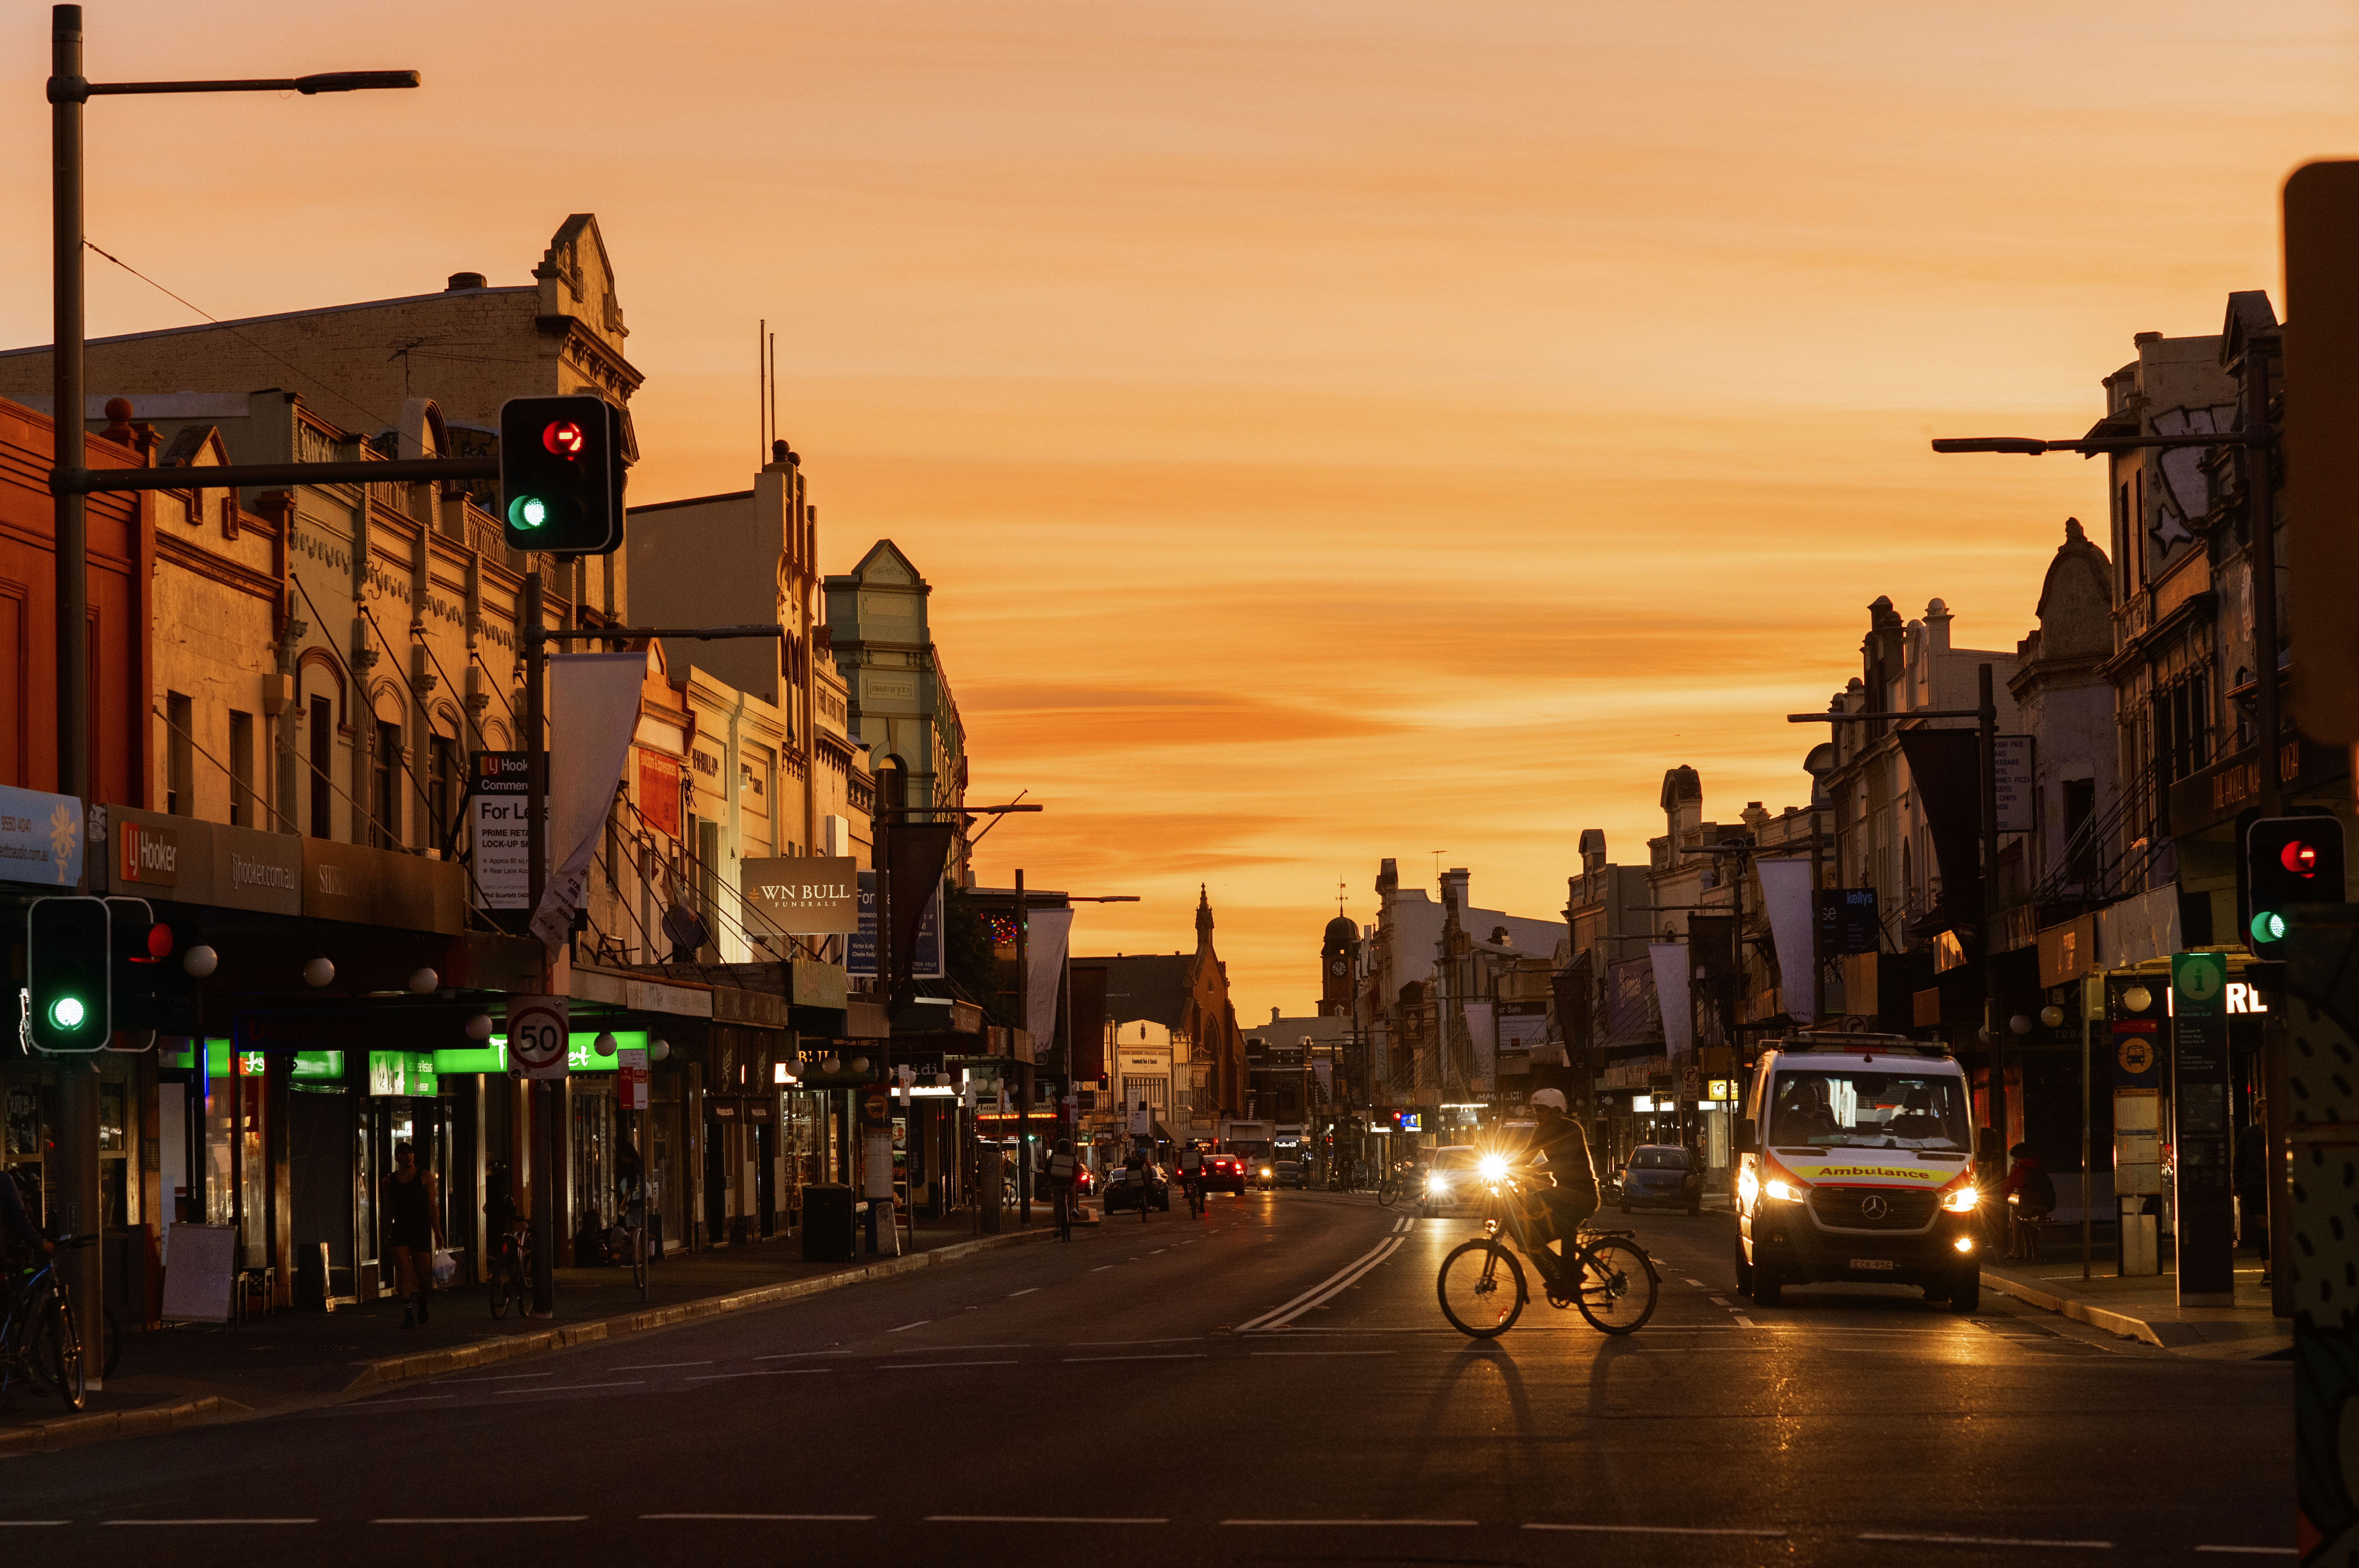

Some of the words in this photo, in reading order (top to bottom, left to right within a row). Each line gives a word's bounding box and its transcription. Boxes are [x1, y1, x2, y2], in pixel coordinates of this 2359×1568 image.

[489, 758, 498, 774] LJ
[501, 758, 528, 771] Hook
[481, 779, 528, 791] Commer
[481, 802, 509, 820] For
[129, 829, 138, 877] LJ
[140, 831, 177, 872] Hooker
[760, 885, 796, 900] WN
[802, 884, 850, 899] BULL
[1847, 891, 1873, 907] kellys
[521, 1025, 556, 1052] 50
[1037, 1120, 1057, 1131] Foo
[1818, 1167, 1930, 1179] Ambulance
